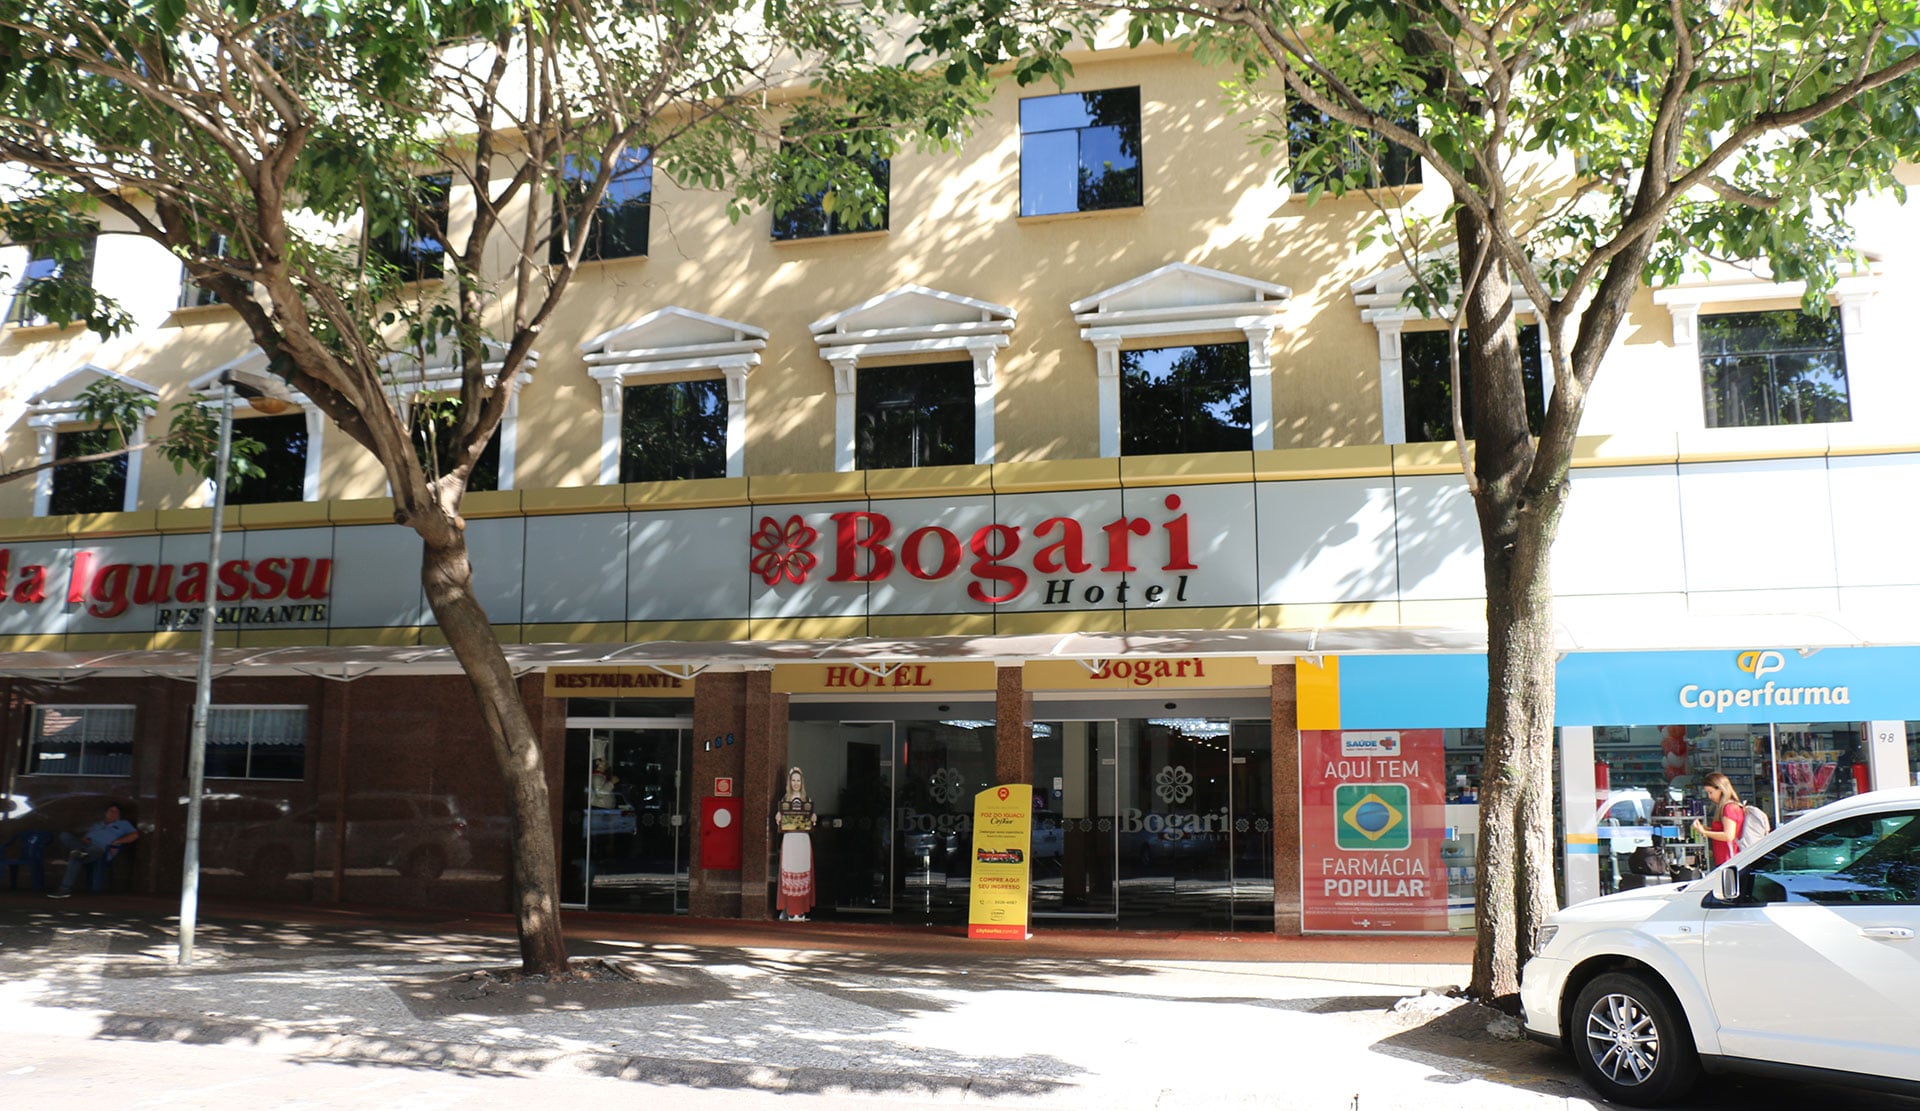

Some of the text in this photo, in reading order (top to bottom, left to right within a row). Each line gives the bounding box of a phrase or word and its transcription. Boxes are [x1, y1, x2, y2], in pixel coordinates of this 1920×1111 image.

[827, 494, 1198, 603] Bogari
[67, 551, 333, 619] Iguassu
[1043, 575, 1188, 605] Hotel
[158, 603, 327, 626] RESAURANTE
[554, 672, 683, 688] RESTAURANTE
[824, 665, 932, 688] HOTEL
[1679, 681, 1850, 713] Coperfarma
[1346, 738, 1377, 748] SAÚDE
[1879, 732, 1895, 744] 98
[1324, 760, 1419, 780] AQUI TEM
[896, 806, 972, 839] Boga
[1121, 806, 1231, 840] Bogari
[1322, 854, 1425, 876] FARMÁCIA
[1324, 879, 1424, 897] POPULAR
